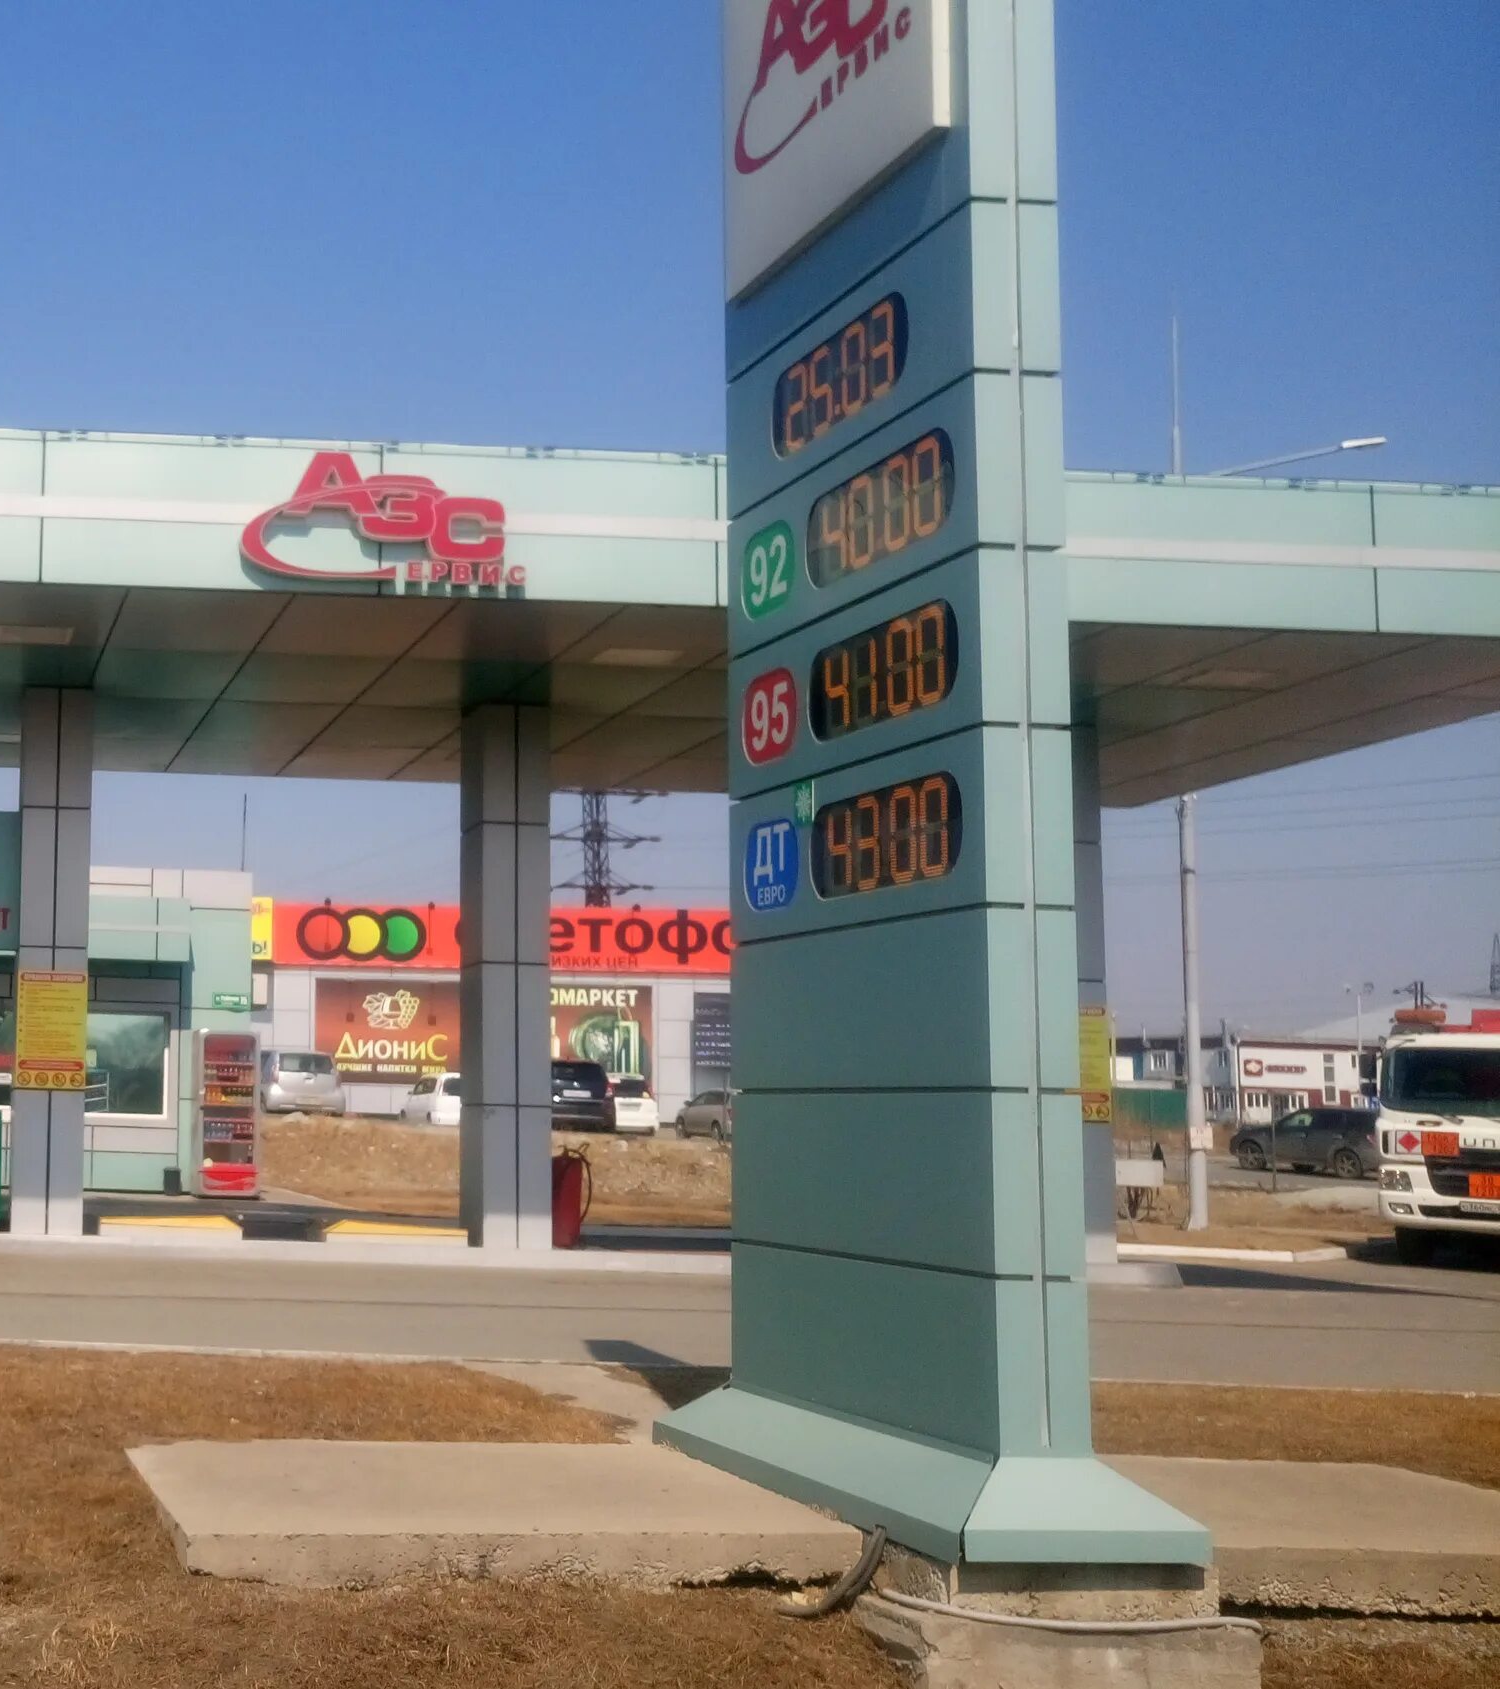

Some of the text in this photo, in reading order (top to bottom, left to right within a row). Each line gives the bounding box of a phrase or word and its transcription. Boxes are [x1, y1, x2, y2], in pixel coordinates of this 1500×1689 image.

[749, 533, 788, 607] 92
[750, 681, 789, 751] 95
[753, 822, 790, 887] ДТ
[757, 884, 786, 906] ЕВРО
[376, 1063, 417, 1073] НАПИТКИ
